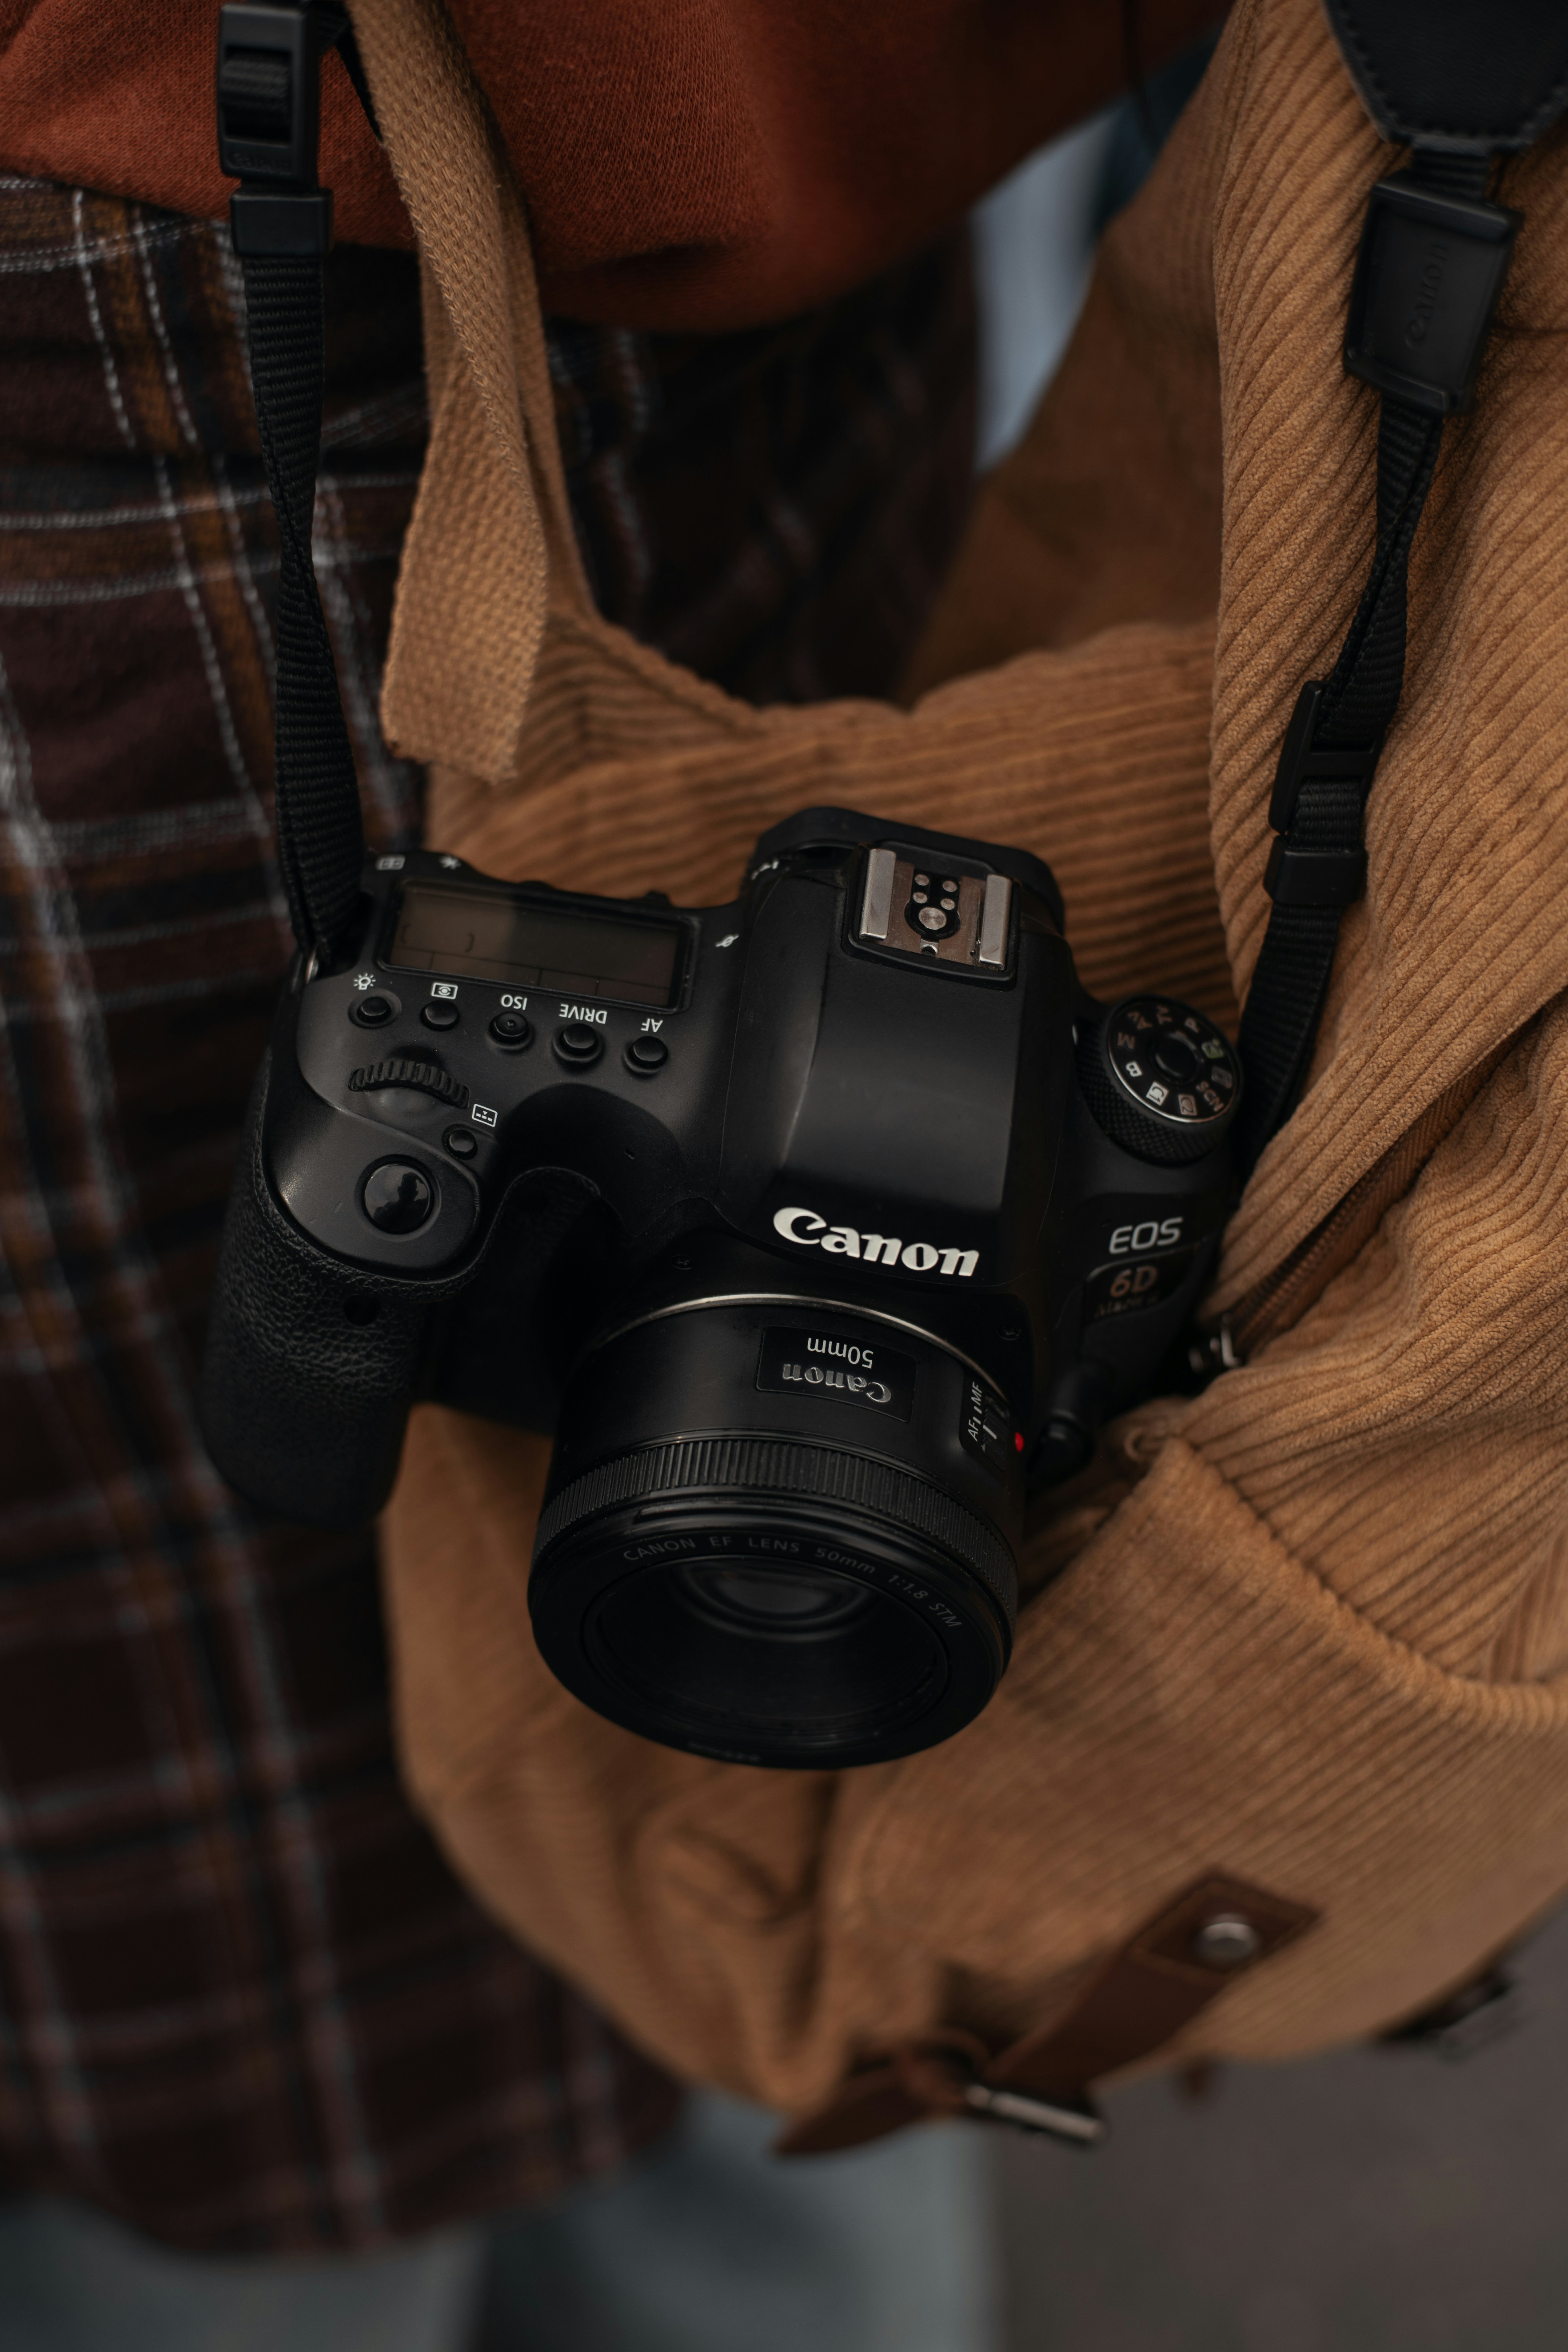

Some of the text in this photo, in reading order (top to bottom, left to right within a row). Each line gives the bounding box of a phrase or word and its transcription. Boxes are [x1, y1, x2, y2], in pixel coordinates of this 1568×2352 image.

[1405, 243, 1448, 350] Canon
[500, 994, 528, 1011] ISO
[558, 1003, 608, 1024] DRIVE
[640, 1018, 664, 1033] AF
[1117, 1032, 1135, 1050] M
[1125, 1060, 1143, 1078] B
[1147, 1083, 1167, 1104] C1
[1179, 1095, 1195, 1114] C2
[1196, 1081, 1224, 1112] SCN
[773, 1206, 980, 1277] Canon
[1108, 1217, 1183, 1254] EOS
[1110, 1265, 1158, 1298] 6D
[807, 1337, 874, 1369] 50mm
[782, 1364, 892, 1403] Canon
[971, 1381, 983, 1406] MF
[967, 1419, 979, 1442] AF
[623, 1536, 963, 1627] CANON EF LENS 50mm 1:1.8 STM
